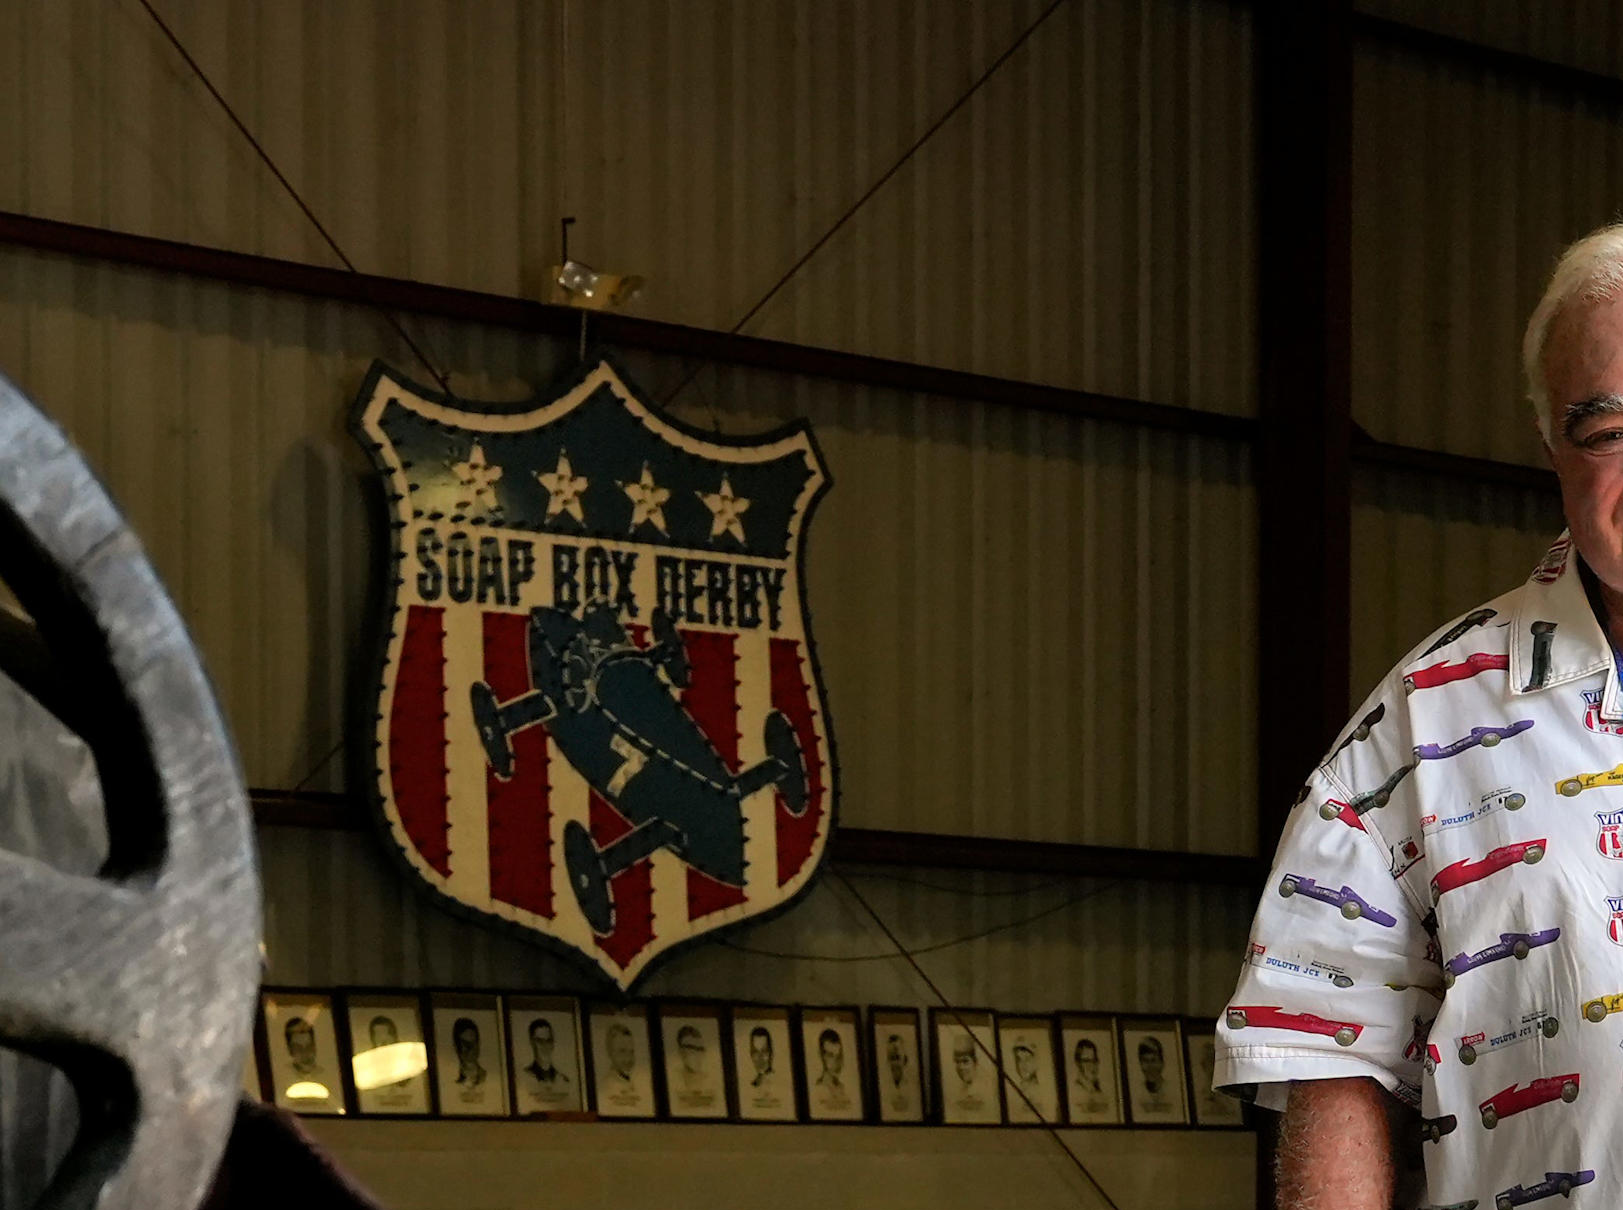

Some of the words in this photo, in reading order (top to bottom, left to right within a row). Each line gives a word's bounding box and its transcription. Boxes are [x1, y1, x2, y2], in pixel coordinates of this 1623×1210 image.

[416, 527, 533, 606] SOAP
[552, 544, 641, 618] BOX
[656, 555, 787, 632] DERBY
[1441, 811, 1476, 826] DULUTH
[1266, 957, 1300, 974] DULUTH
